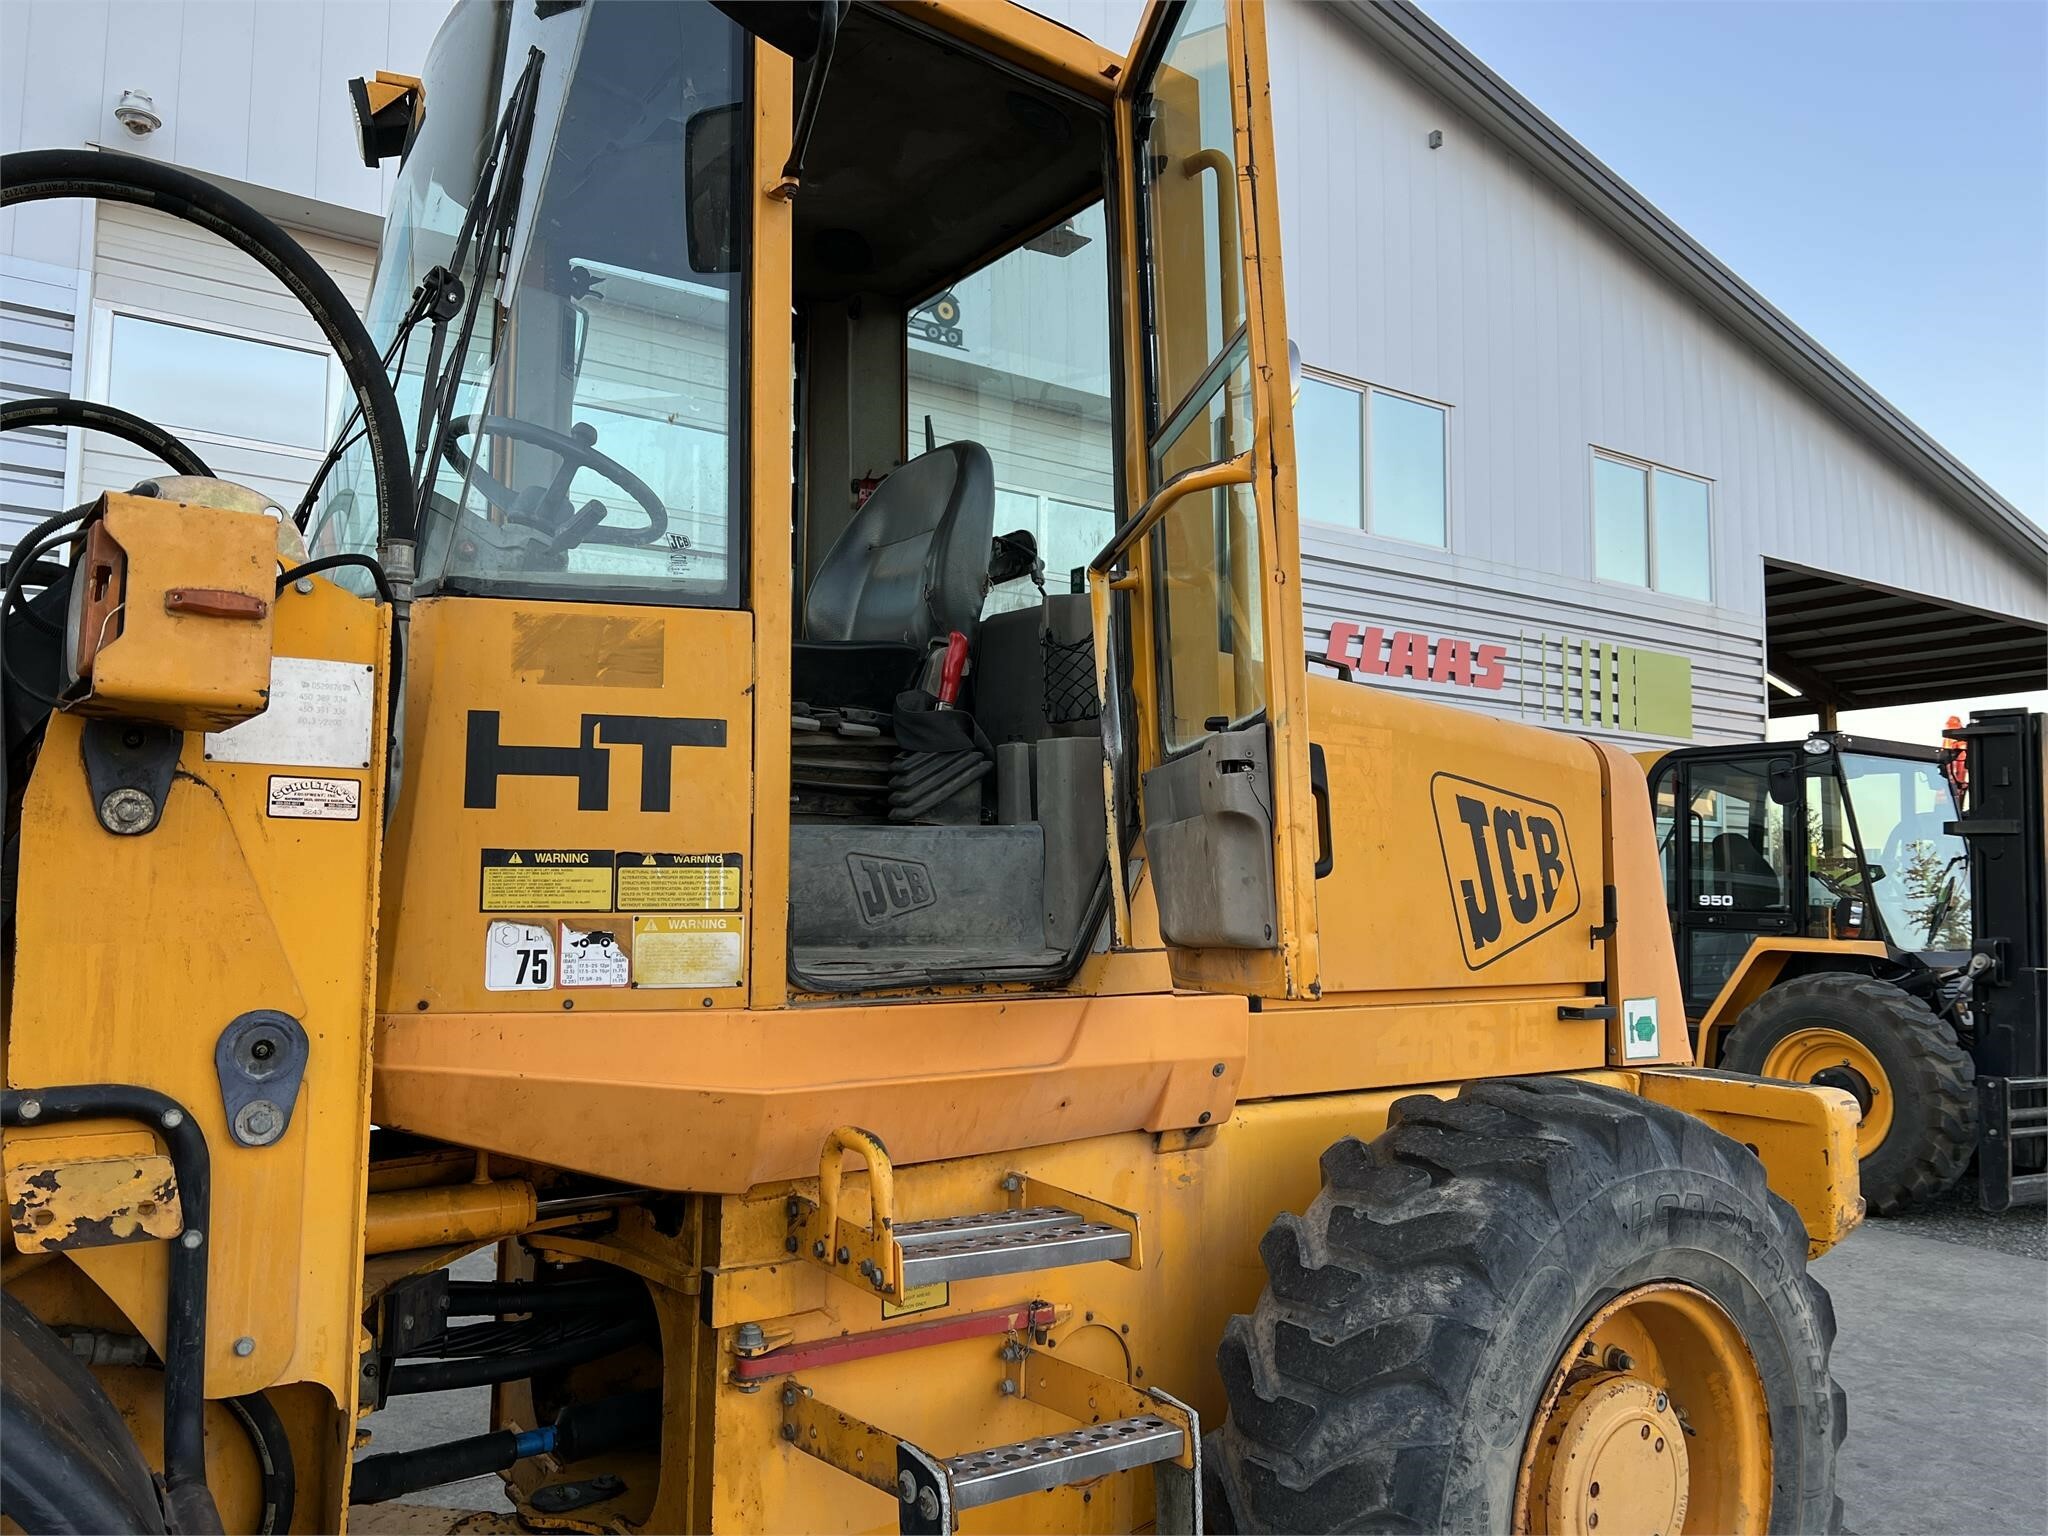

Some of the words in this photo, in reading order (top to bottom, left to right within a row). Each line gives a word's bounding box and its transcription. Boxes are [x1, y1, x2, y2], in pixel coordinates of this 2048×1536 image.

[671, 534, 689, 550] JCB
[1326, 622, 1507, 691] CLAAS
[464, 709, 728, 812] HT
[534, 852, 589, 864] WARNING
[673, 854, 722, 864] WARNING
[1456, 794, 1565, 951] JCB
[860, 860, 930, 918] JCB
[1700, 894, 1734, 906] 950
[668, 918, 727, 930] WARNING
[516, 949, 548, 985] 75
